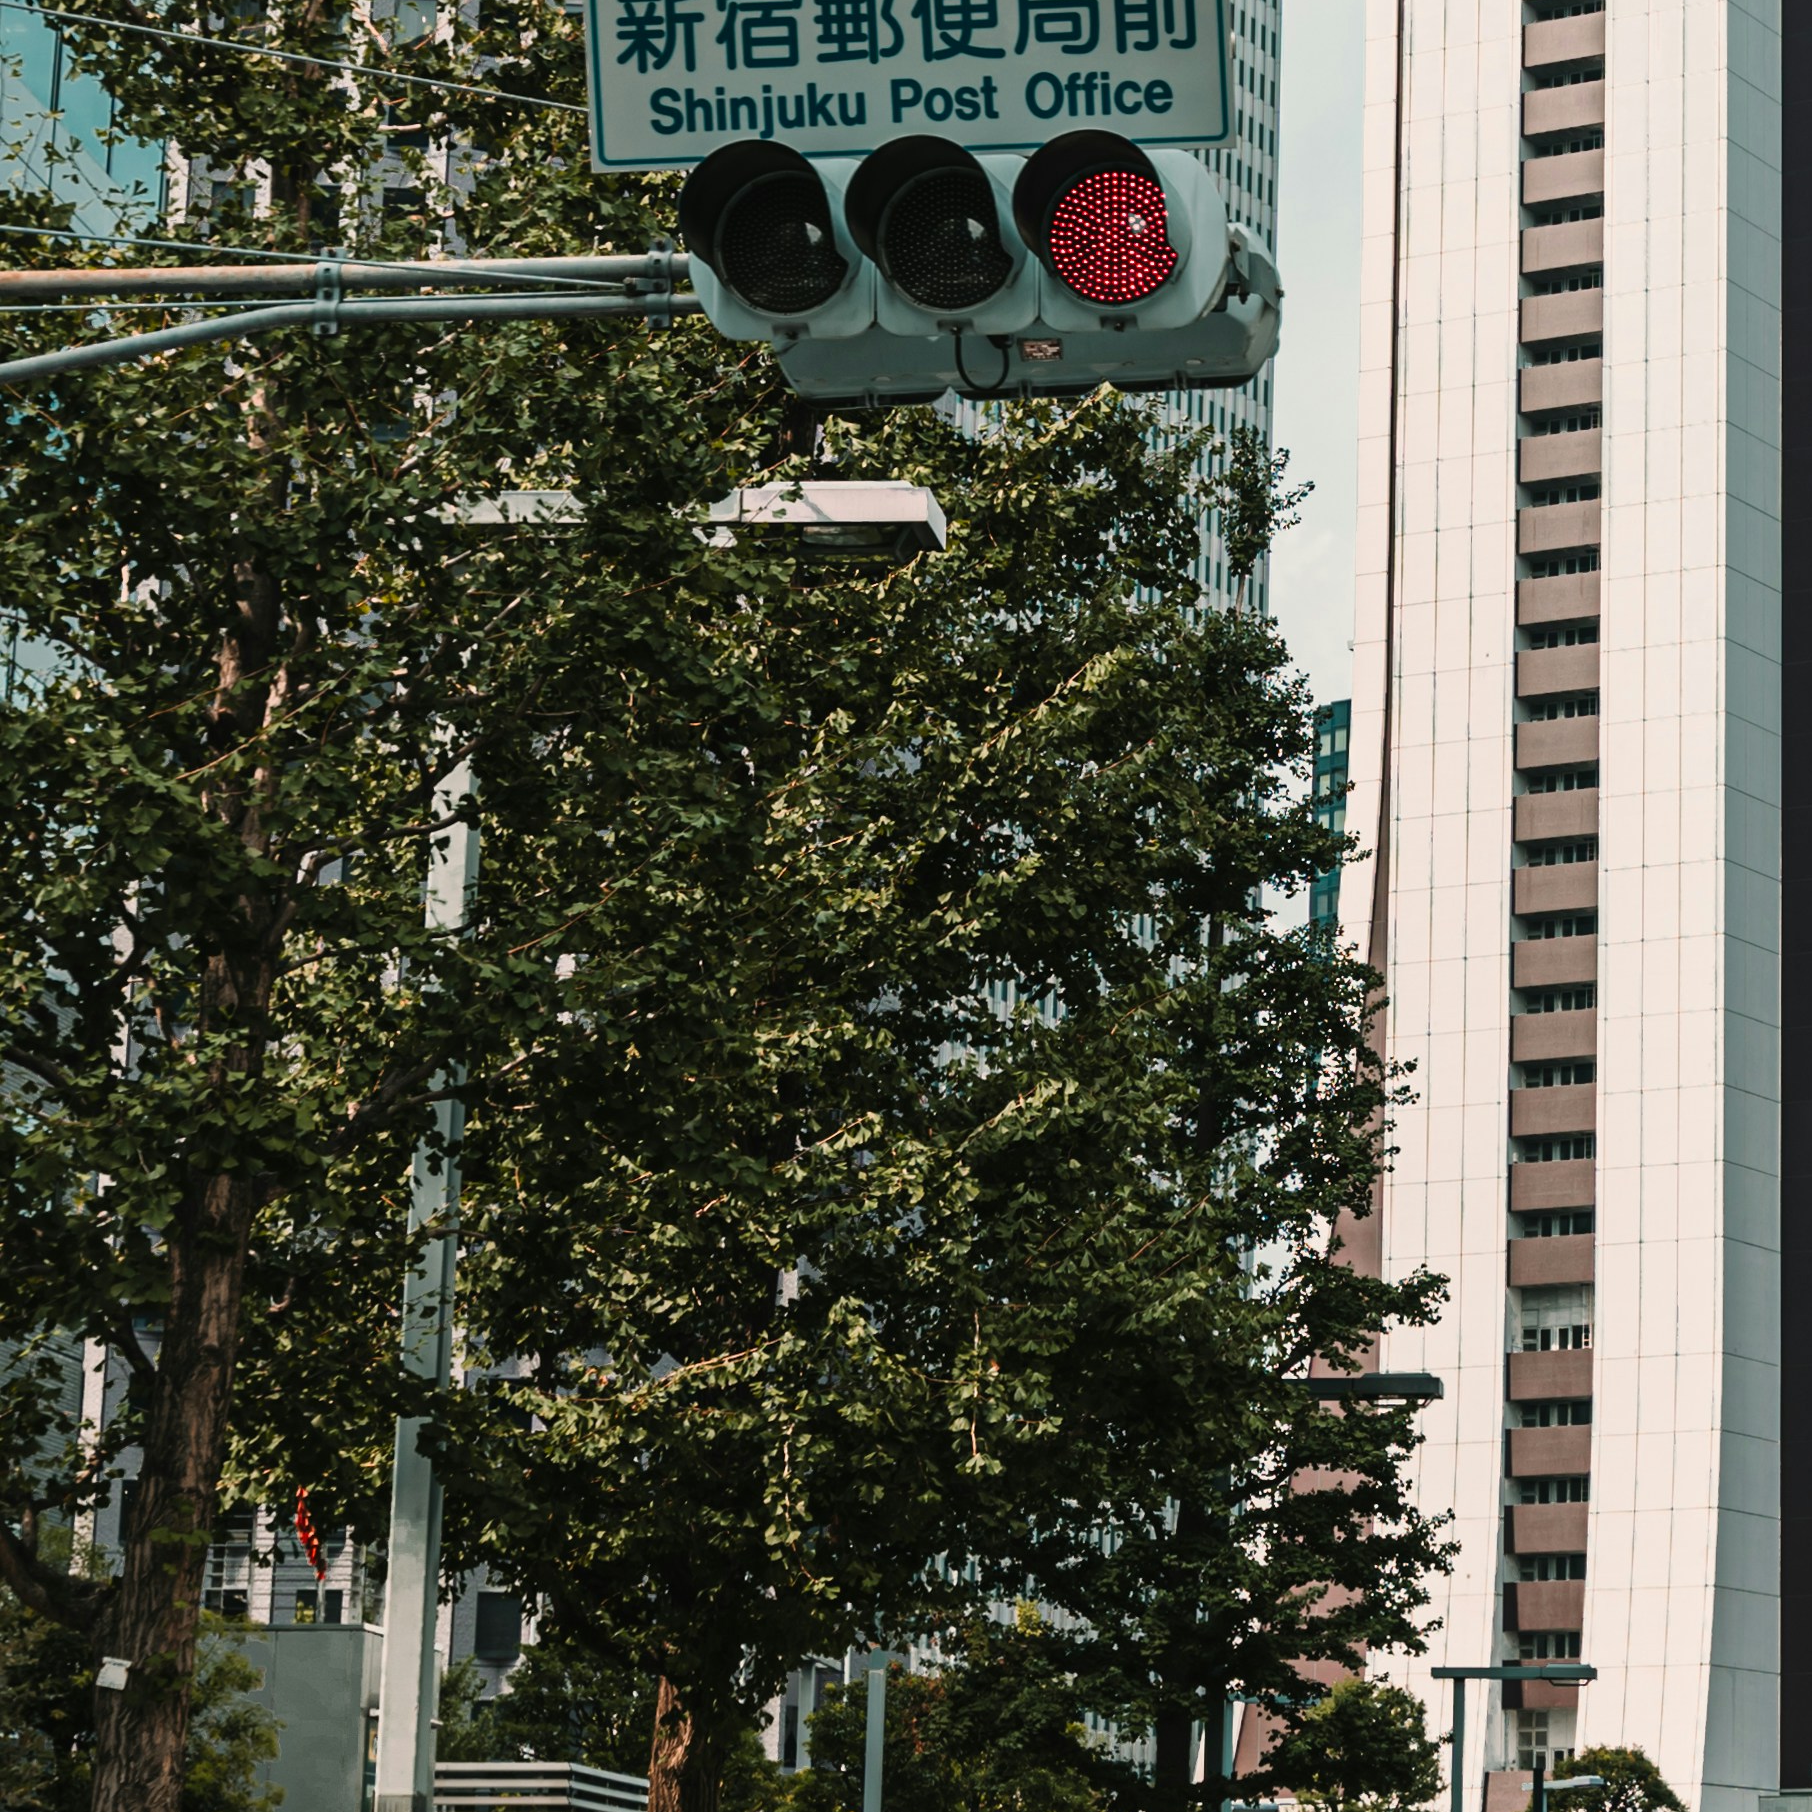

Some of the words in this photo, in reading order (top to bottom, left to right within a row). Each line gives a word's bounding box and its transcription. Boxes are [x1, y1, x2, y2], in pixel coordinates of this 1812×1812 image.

[650, 82, 867, 139] Shinjuku
[890, 75, 1000, 124] Post
[1024, 71, 1174, 120] Office
